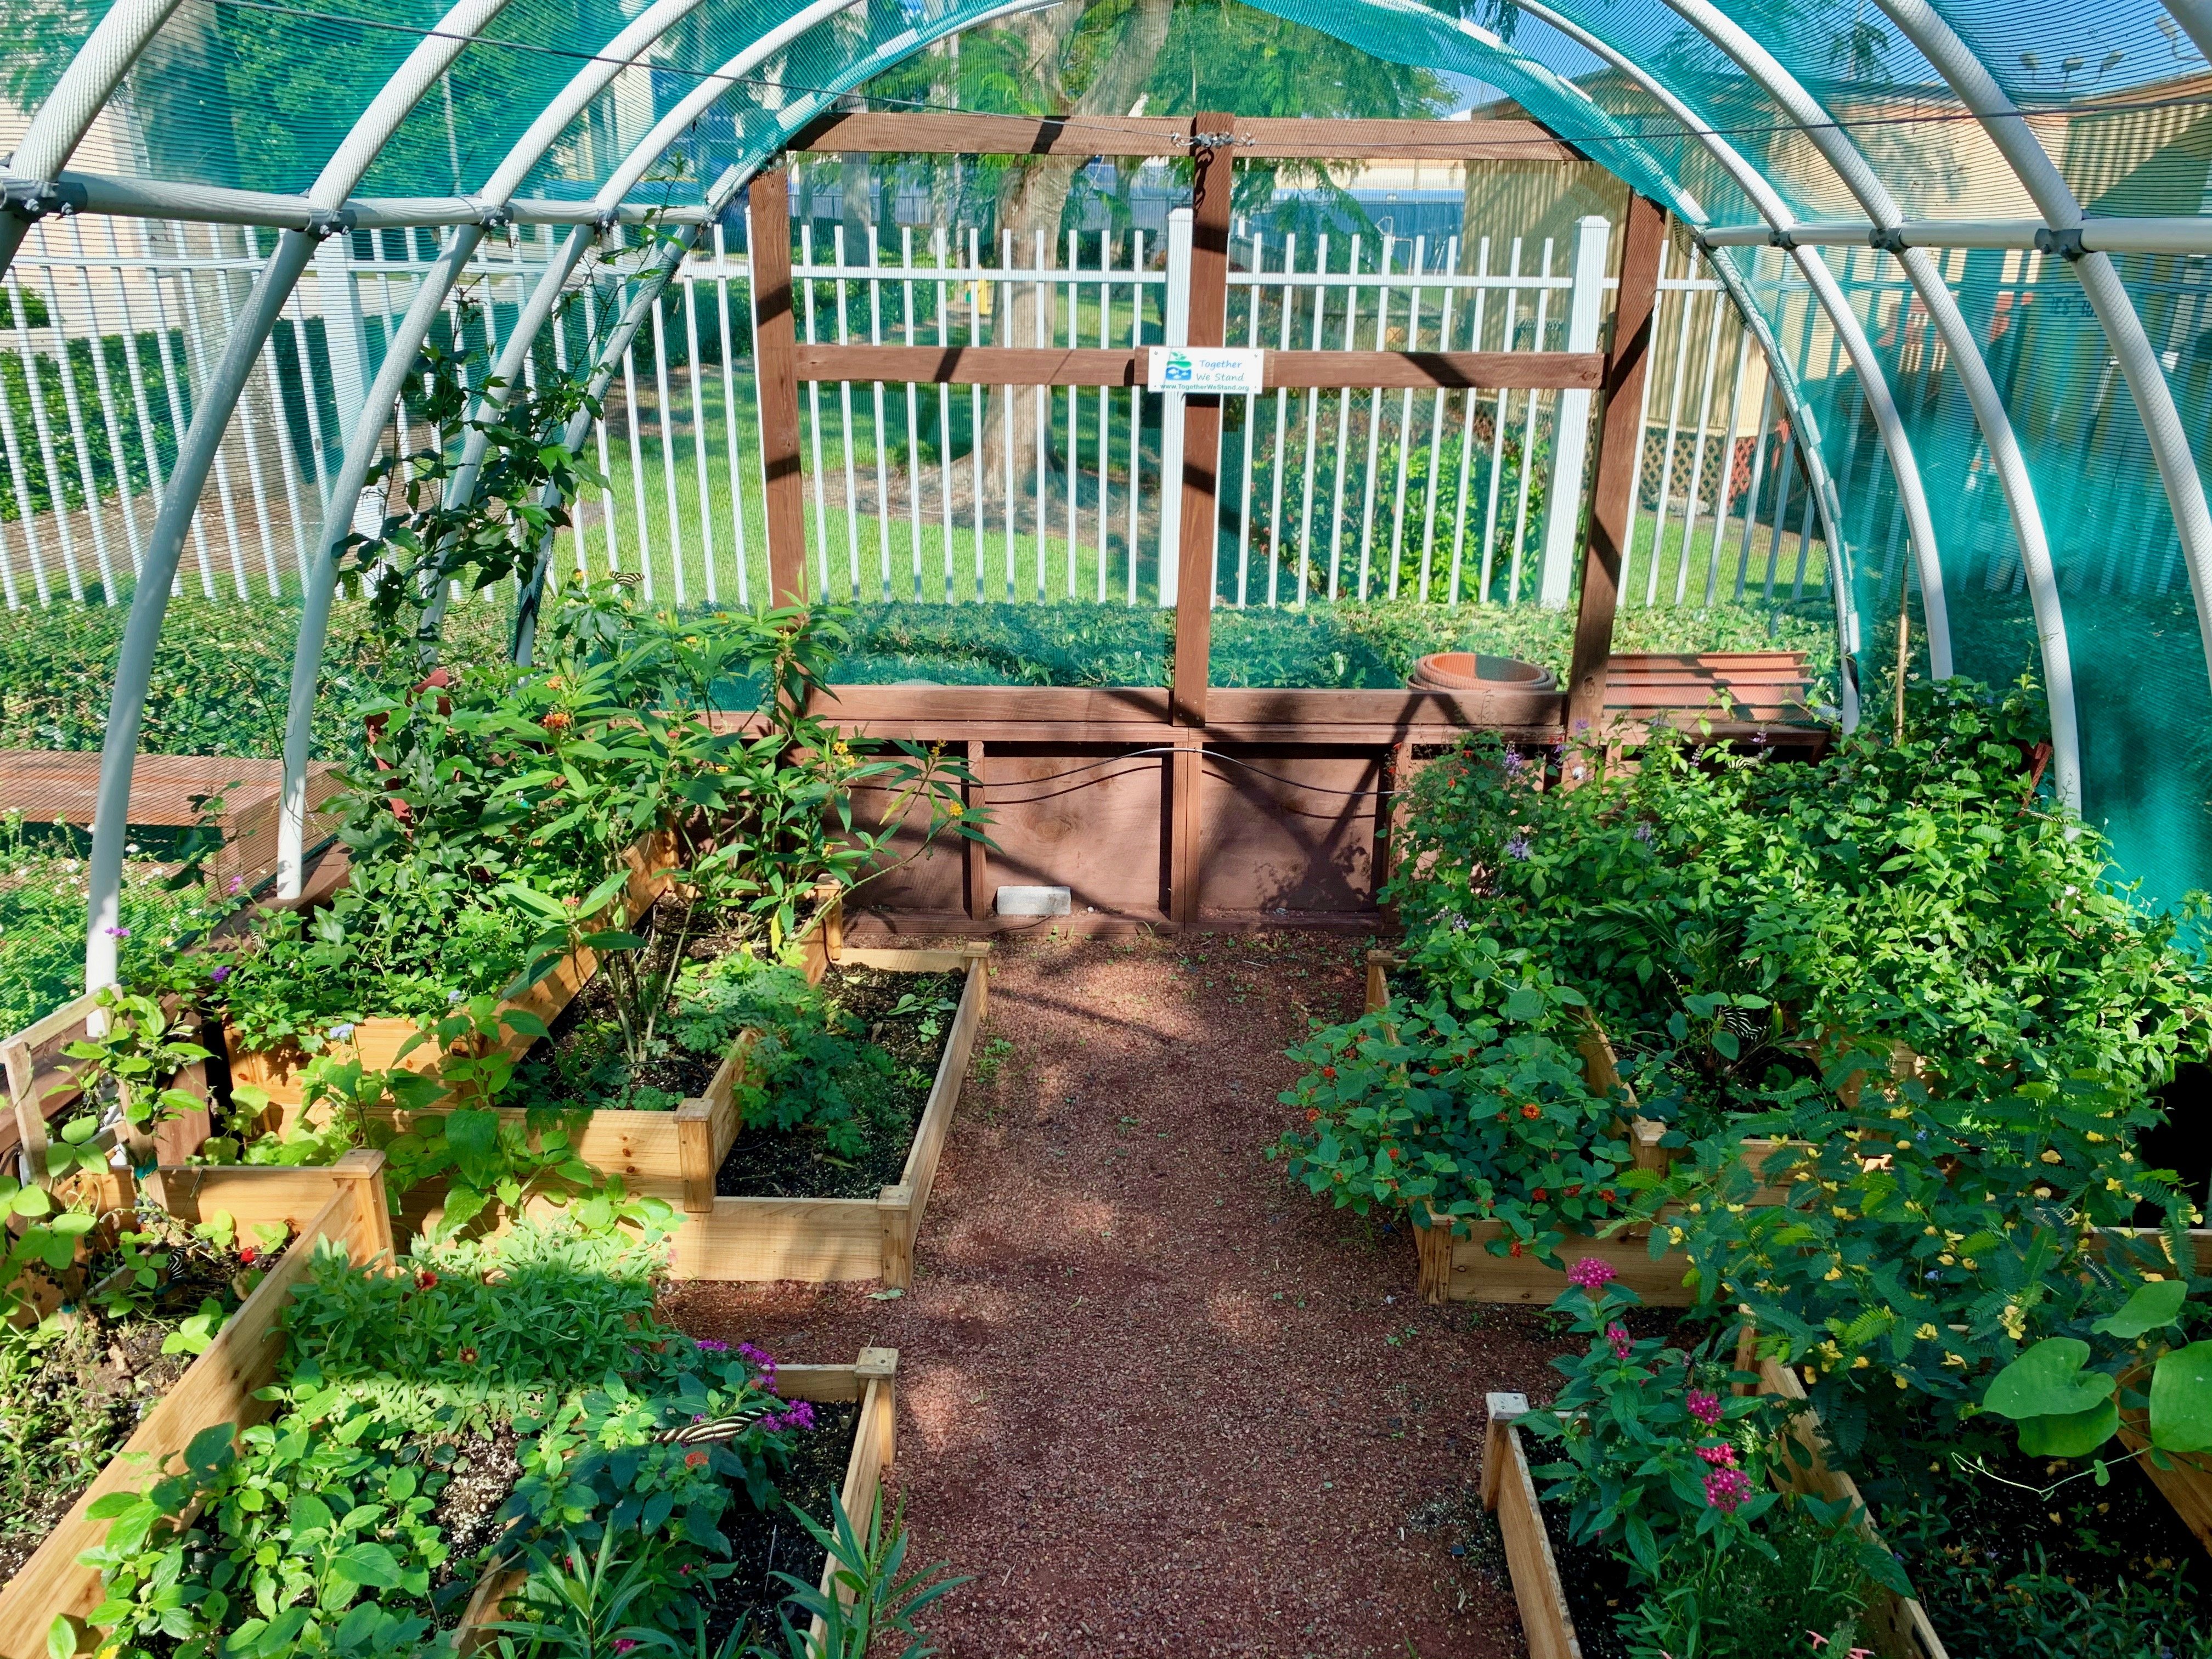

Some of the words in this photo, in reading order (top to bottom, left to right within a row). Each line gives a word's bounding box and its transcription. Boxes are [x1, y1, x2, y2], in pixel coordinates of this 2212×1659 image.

[1199, 359, 1242, 371] Together
[1196, 373, 1210, 381] We
[1215, 373, 1244, 381] Stand
